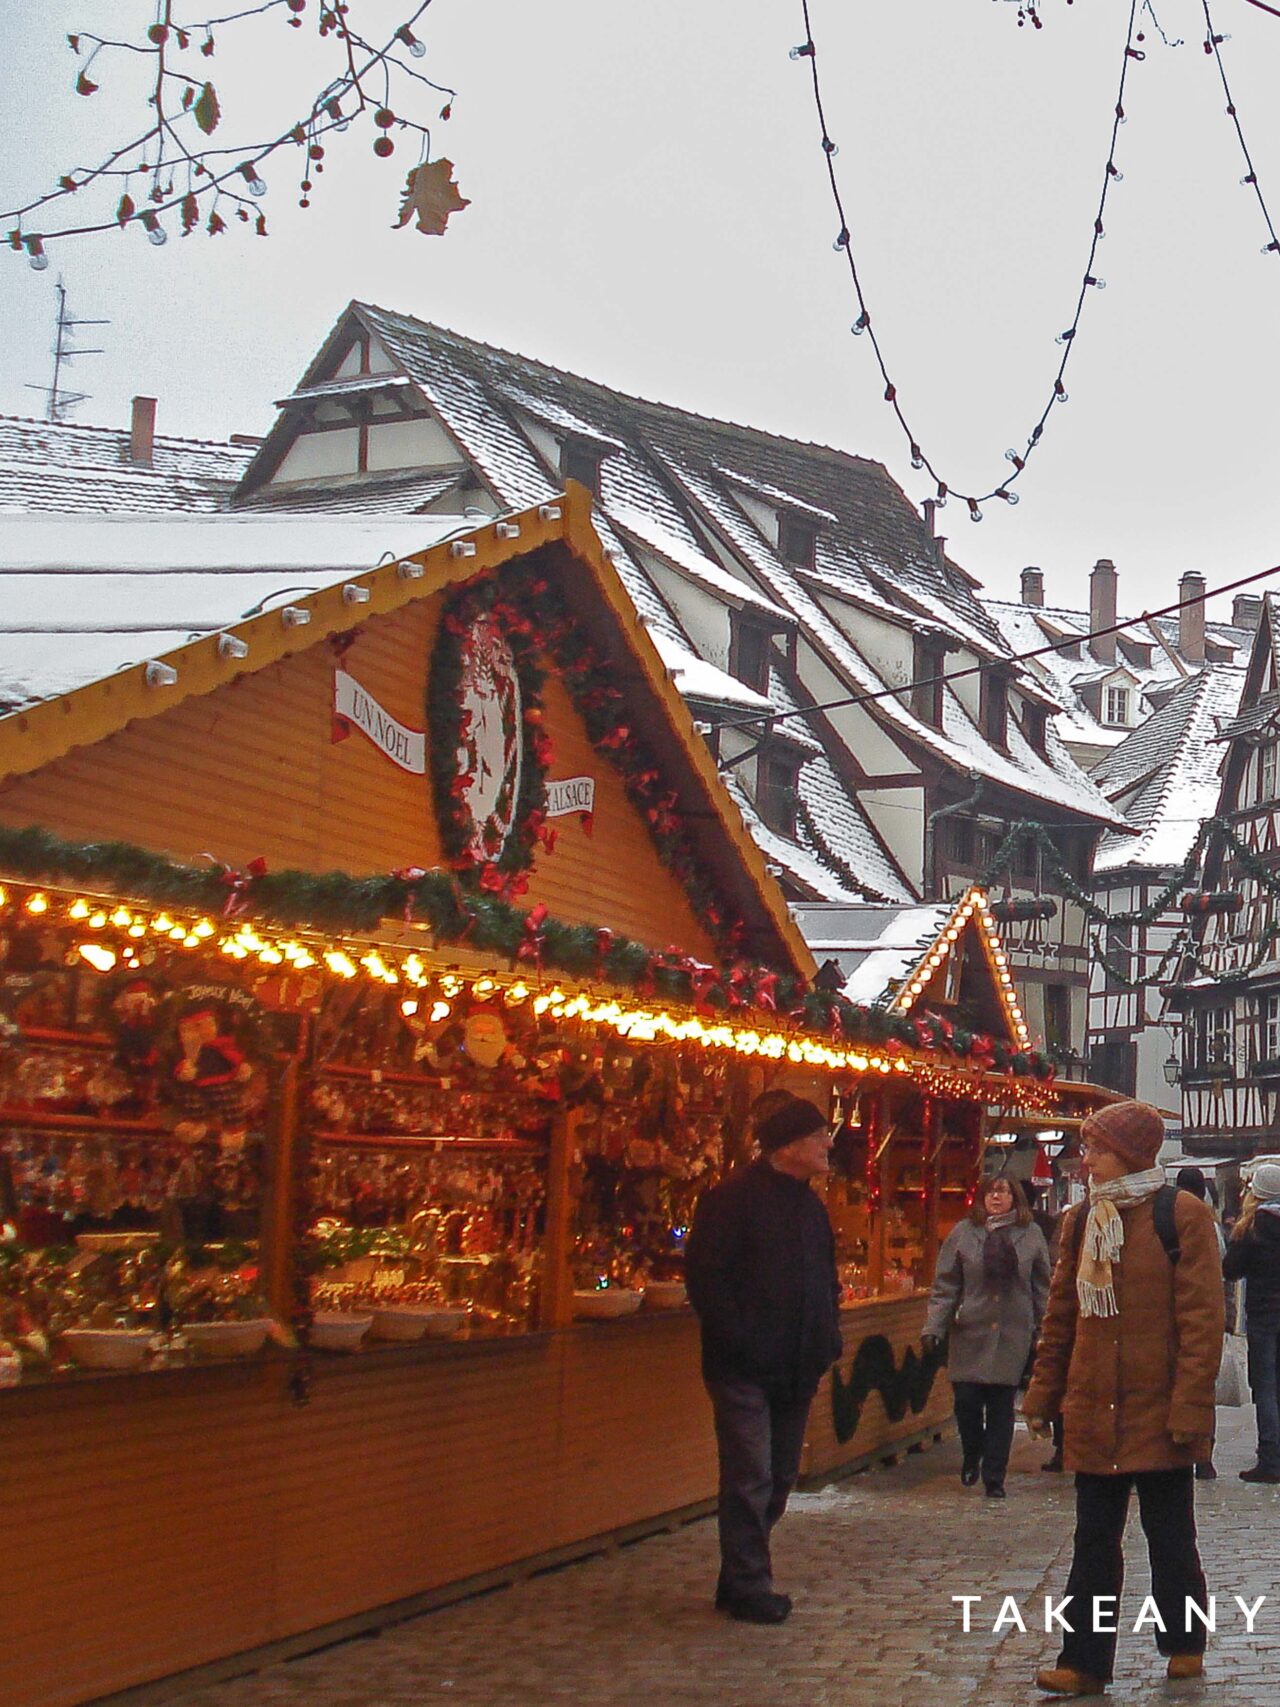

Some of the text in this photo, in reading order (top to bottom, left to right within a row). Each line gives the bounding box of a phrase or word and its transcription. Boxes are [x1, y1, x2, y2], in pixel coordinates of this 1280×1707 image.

[352, 689, 412, 766] UN NOEL
[552, 782, 591, 812] ALSACE
